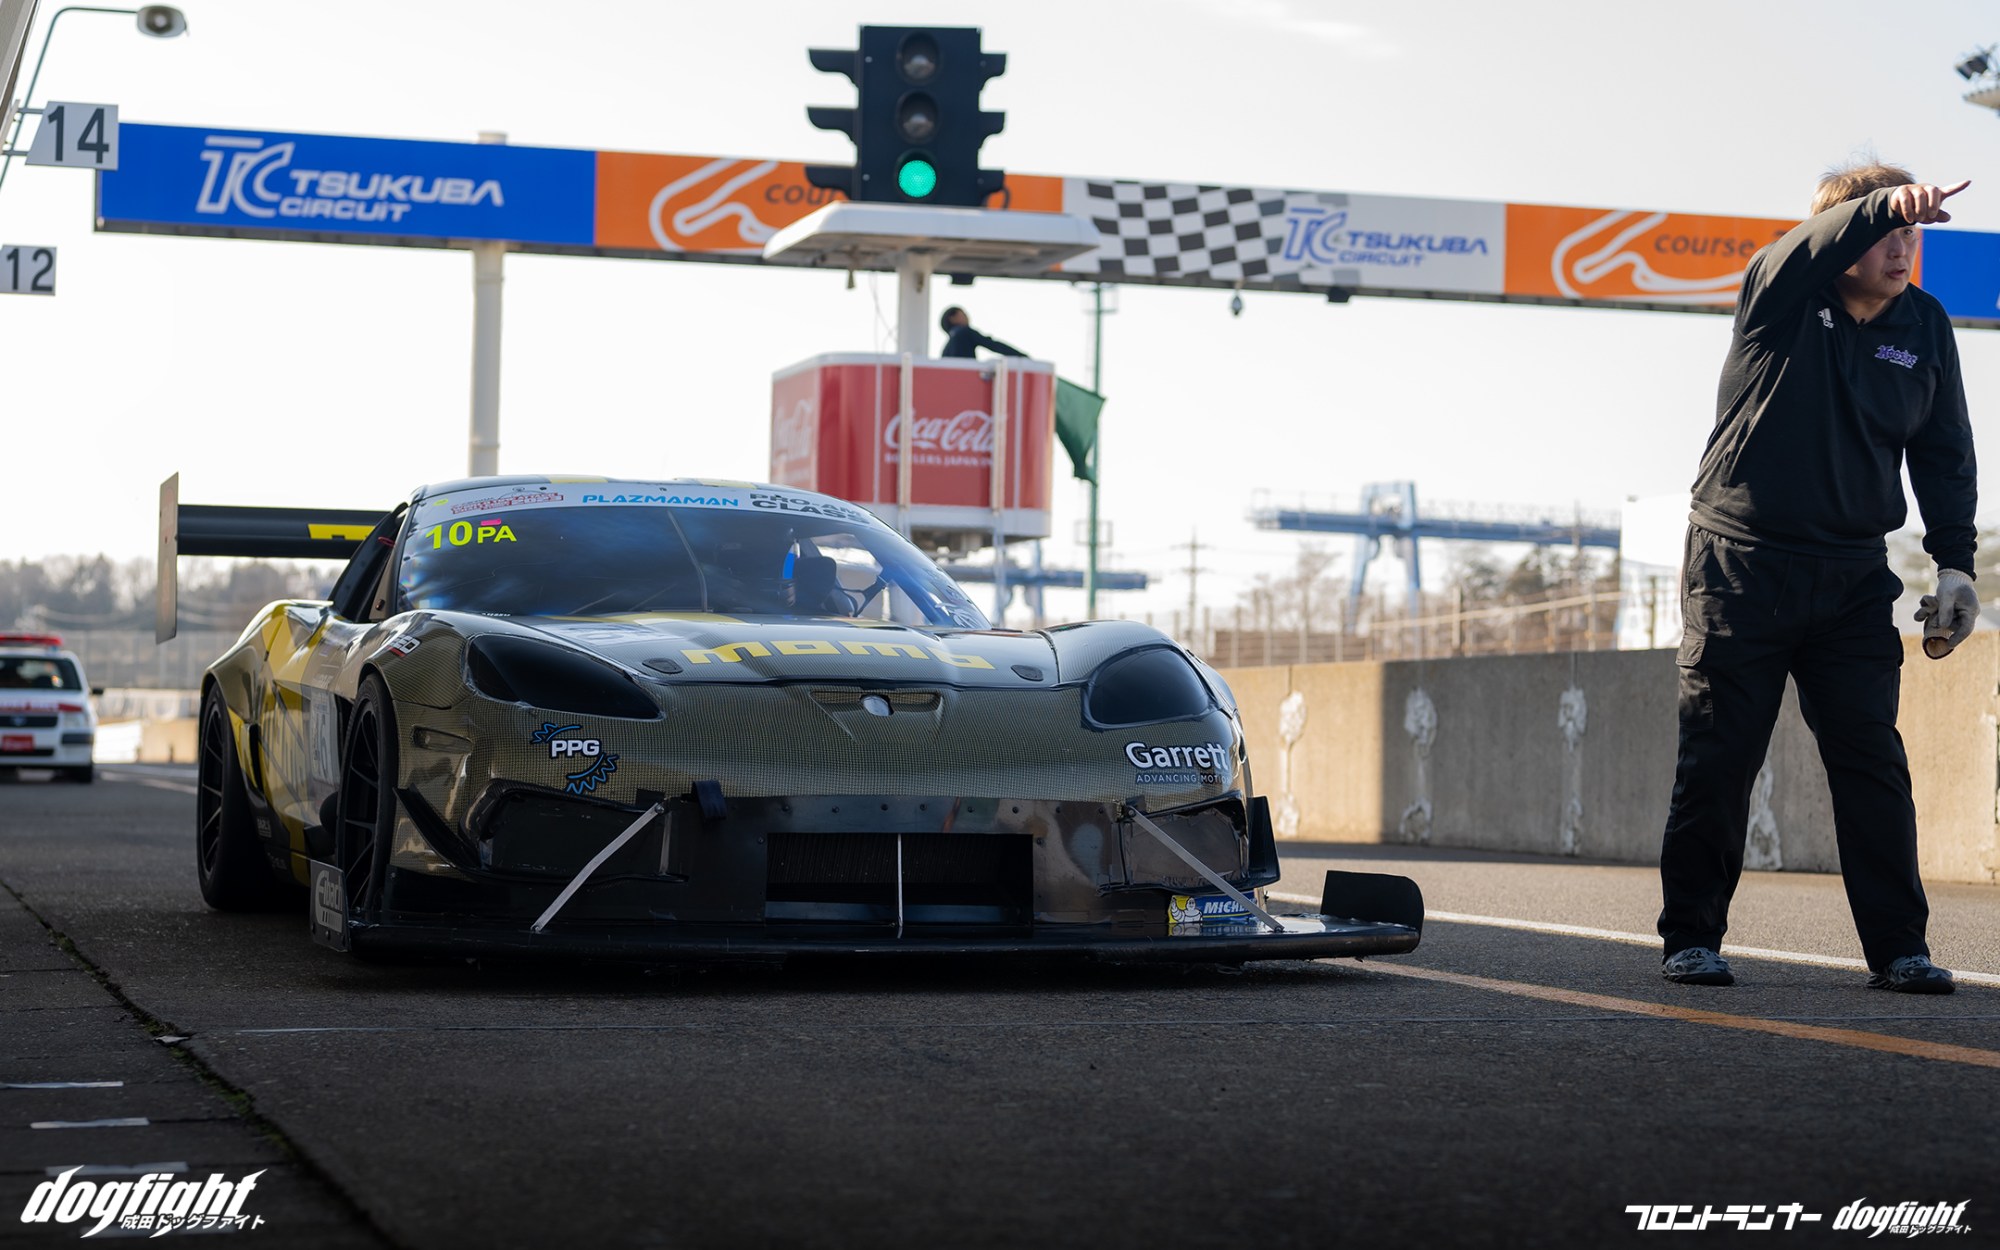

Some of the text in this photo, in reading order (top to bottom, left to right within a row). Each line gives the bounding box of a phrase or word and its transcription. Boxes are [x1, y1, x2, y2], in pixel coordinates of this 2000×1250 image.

[48, 105, 109, 163] 14
[290, 169, 504, 206] TSUKUBA
[1347, 230, 1488, 255] TSUKUBA
[1654, 234, 1755, 257] course
[6, 248, 53, 292] 12
[582, 494, 739, 507] PLAZMAMAN
[751, 500, 871, 524] CLASS
[551, 740, 600, 757] PPG
[1125, 742, 1229, 770] Garrett
[1136, 774, 1198, 783] ADVANCING
